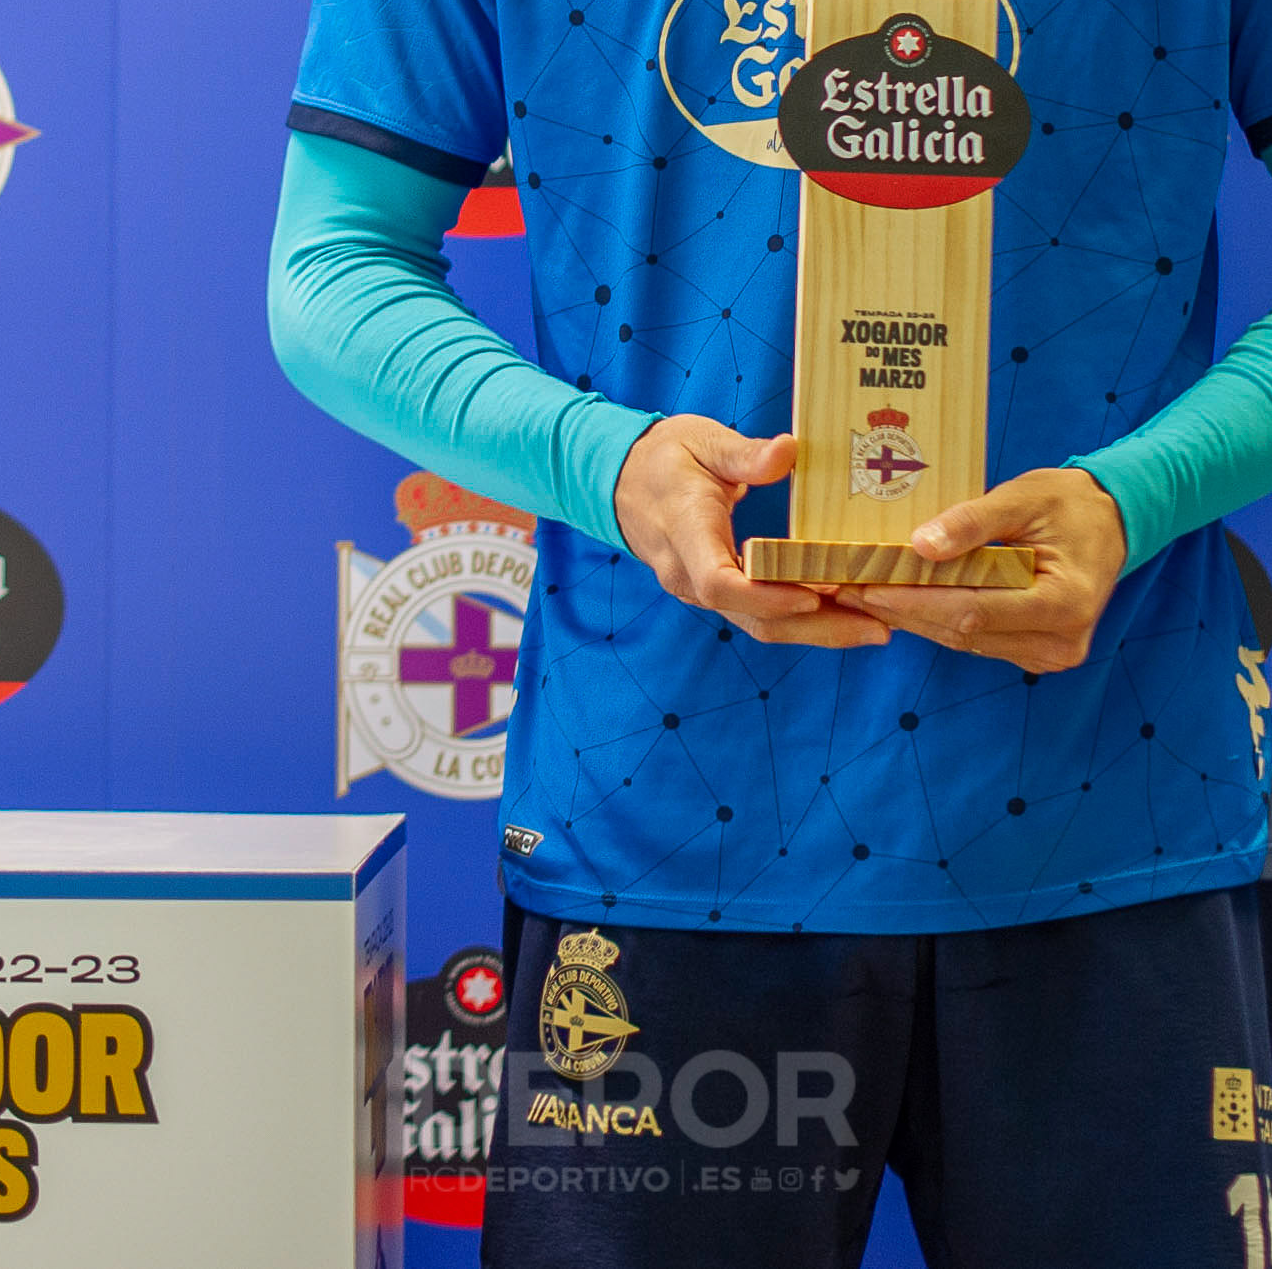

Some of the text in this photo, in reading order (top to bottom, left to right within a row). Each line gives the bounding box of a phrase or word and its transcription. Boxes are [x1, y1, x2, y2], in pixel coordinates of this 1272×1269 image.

[820, 68, 993, 119] Estrella
[827, 114, 986, 164] Galicia
[841, 319, 948, 347] XOGADOR
[865, 346, 923, 368] DO MES
[859, 368, 927, 390] MARZO
[363, 586, 411, 642] REAL
[406, 553, 463, 592] CLUB
[431, 753, 458, 783] LA
[579, 970, 619, 1012] DEPORTIVO
